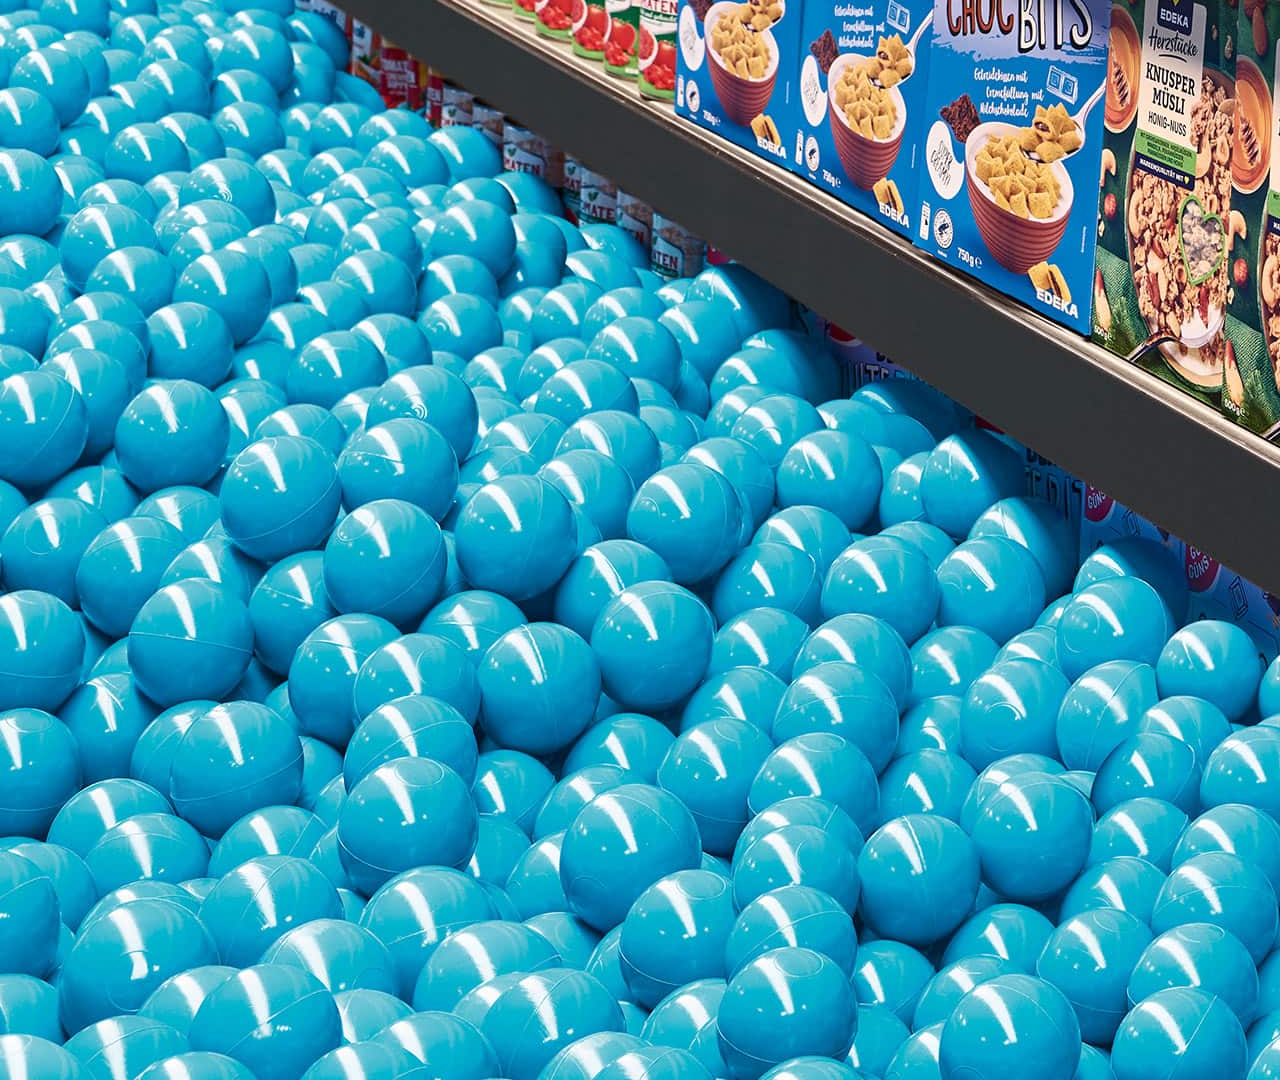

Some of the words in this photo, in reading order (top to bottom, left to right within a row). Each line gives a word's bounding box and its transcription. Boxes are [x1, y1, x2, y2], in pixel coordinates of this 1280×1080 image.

[1160, 9, 1189, 28] EDEKA
[1148, 27, 1198, 57] Herzstücke
[1016, 69, 1028, 82] mit
[1146, 62, 1196, 97] KNUSPER
[1031, 88, 1045, 101] mit
[1152, 87, 1185, 116] MÜSLI
[1148, 111, 1187, 137] HONIG-NUSS
[756, 135, 788, 159] EDEKA
[879, 201, 910, 228] EDEKA
[958, 247, 974, 268] 750g
[1036, 290, 1078, 319] EDEKA
